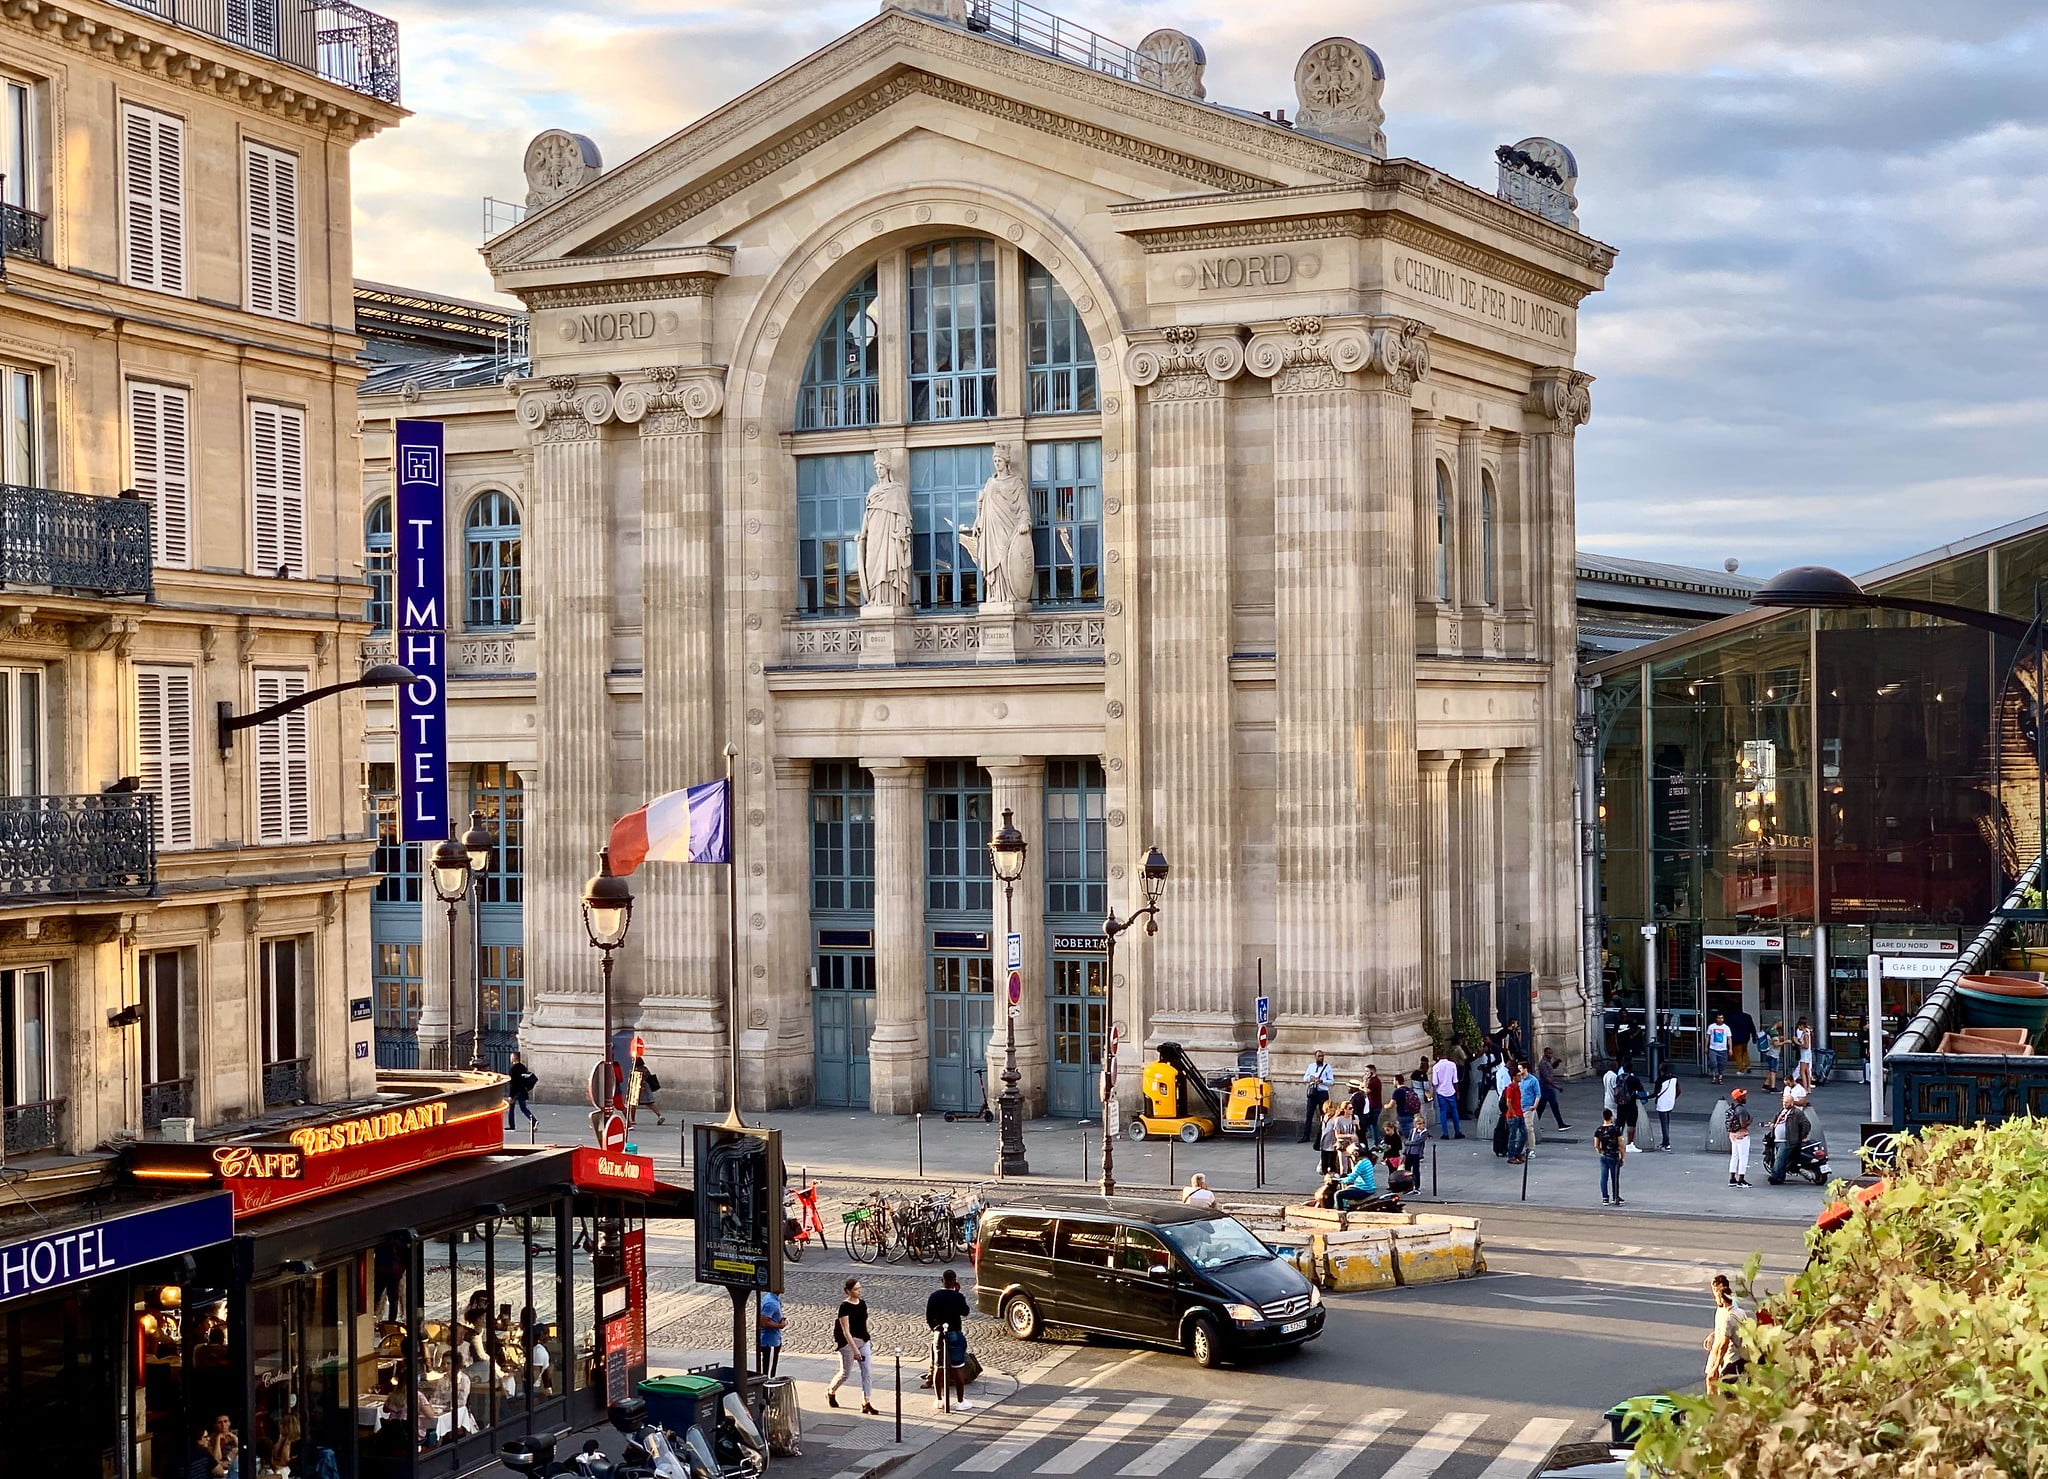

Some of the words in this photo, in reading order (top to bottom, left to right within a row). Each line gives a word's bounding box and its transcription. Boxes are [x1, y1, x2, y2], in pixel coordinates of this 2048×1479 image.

[1199, 253, 1292, 290] NORD
[1405, 257, 1455, 303] CHEMIN
[1460, 277, 1476, 310] DE
[1481, 285, 1506, 321] FER
[1511, 295, 1527, 327] DU
[1531, 302, 1560, 338] NORD
[579, 311, 656, 344] NORD
[404, 519, 439, 821] TIMHOTEL
[1054, 938, 1106, 949] ROBERTA
[1892, 963, 1917, 972] GARE
[1922, 964, 1936, 972] DU
[356, 1042, 367, 1057] 37
[289, 1102, 448, 1156] RESTAURANT
[324, 1165, 370, 1188] Brasserie
[242, 1187, 272, 1210] Café
[0, 1228, 116, 1295] HOTEL
